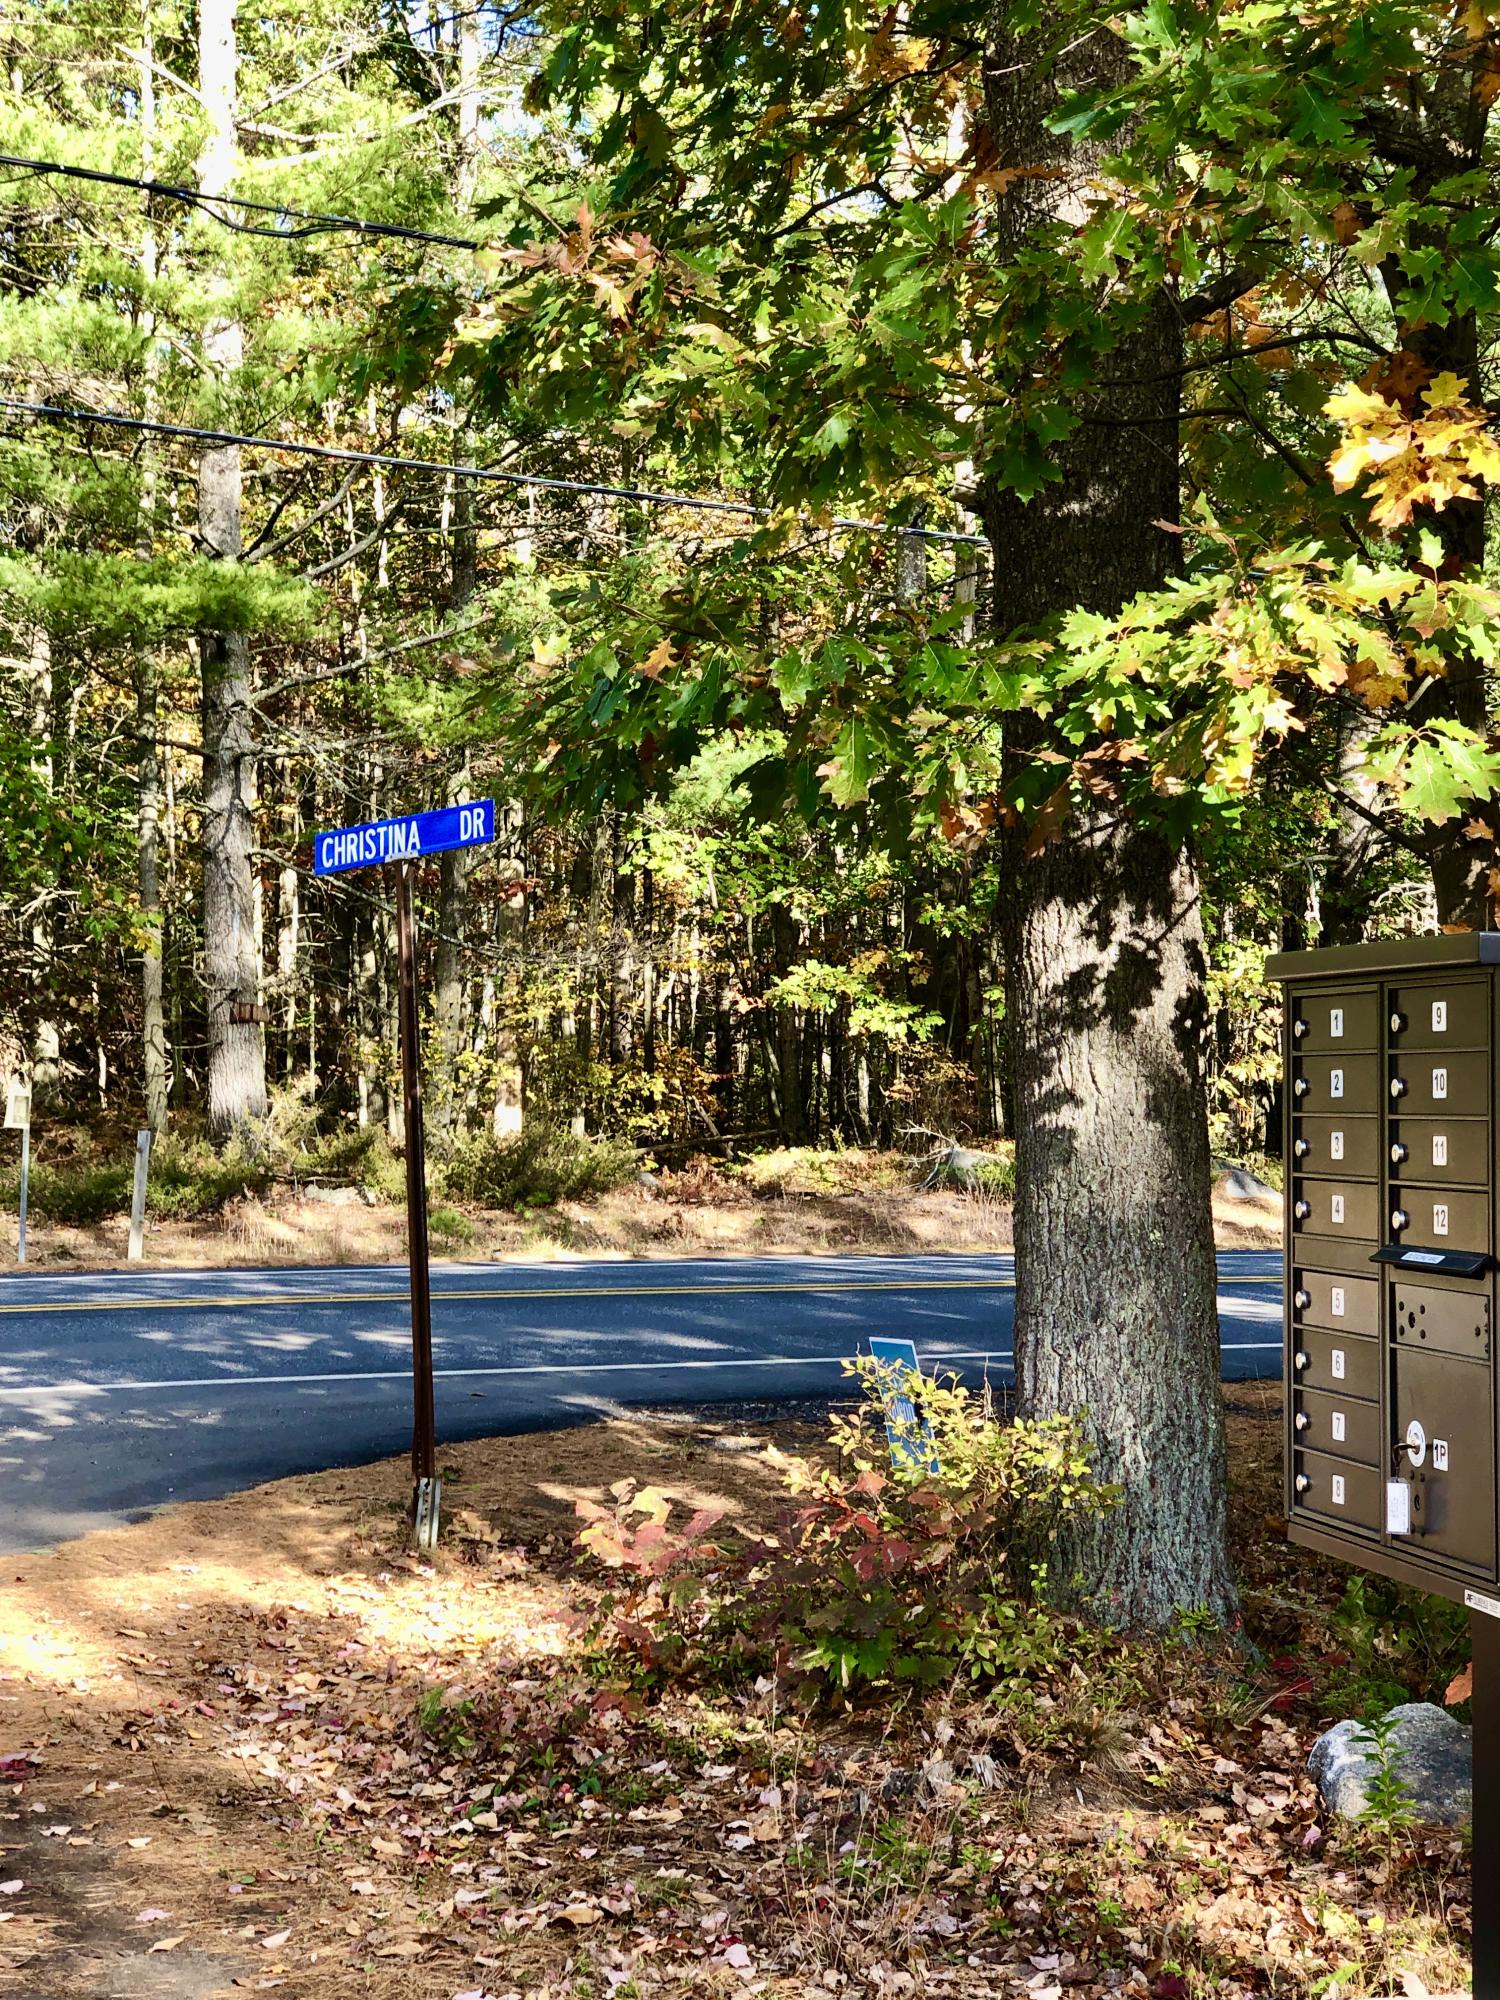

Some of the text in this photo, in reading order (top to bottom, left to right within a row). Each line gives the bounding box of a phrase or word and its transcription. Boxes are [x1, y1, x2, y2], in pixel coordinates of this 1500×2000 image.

[322, 808, 485, 868] CHRISTINA DR
[1335, 1014, 1339, 1030] 1
[1437, 1007, 1442, 1024] 9
[1335, 1075, 1340, 1090] 2
[1434, 1074, 1444, 1091] 10
[1335, 1137, 1340, 1152] 3
[1435, 1142, 1444, 1158] 11
[1335, 1200, 1340, 1216] 4
[1435, 1210, 1446, 1227] 12
[1336, 1293, 1341, 1308] 5
[1336, 1355, 1341, 1371] 6
[1336, 1417, 1341, 1433] 7
[1435, 1444, 1446, 1462] 1P
[1336, 1480, 1341, 1497] 8
